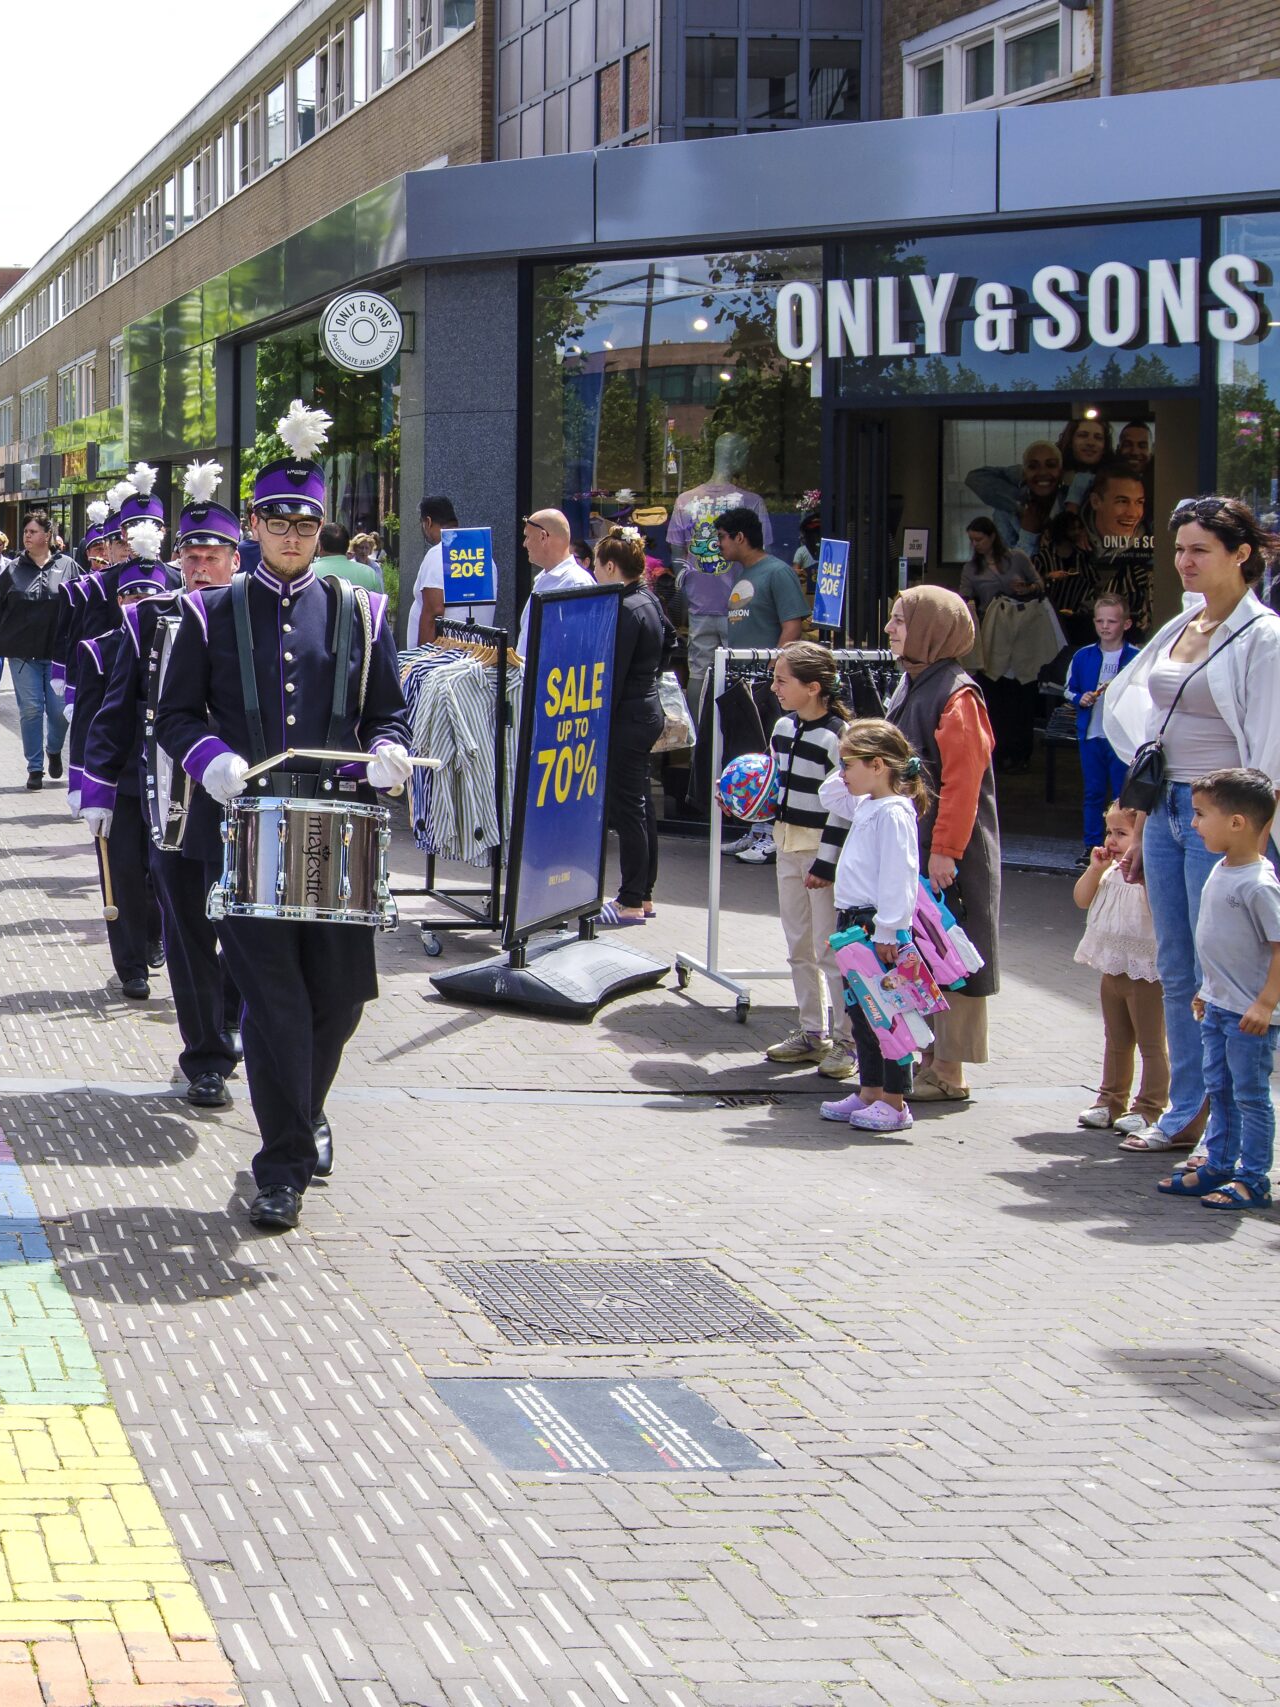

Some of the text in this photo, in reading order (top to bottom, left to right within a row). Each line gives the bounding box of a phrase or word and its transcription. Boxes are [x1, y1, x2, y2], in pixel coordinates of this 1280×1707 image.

[336, 300, 392, 328] ONLY & SONS
[776, 254, 1260, 360] ONLY & SONS
[332, 333, 396, 366] PASSIONATE JEANS MAKERS
[449, 548, 485, 561] SALE
[1103, 535, 1130, 548] ONLY
[1134, 537, 1140, 548] &
[450, 562, 485, 578] 20€
[822, 561, 842, 576] SALE
[820, 578, 840, 596] 20€
[544, 662, 605, 718] SALE
[556, 717, 589, 742] UP TO
[536, 739, 597, 807] 70%
[302, 816, 323, 905] majestic
